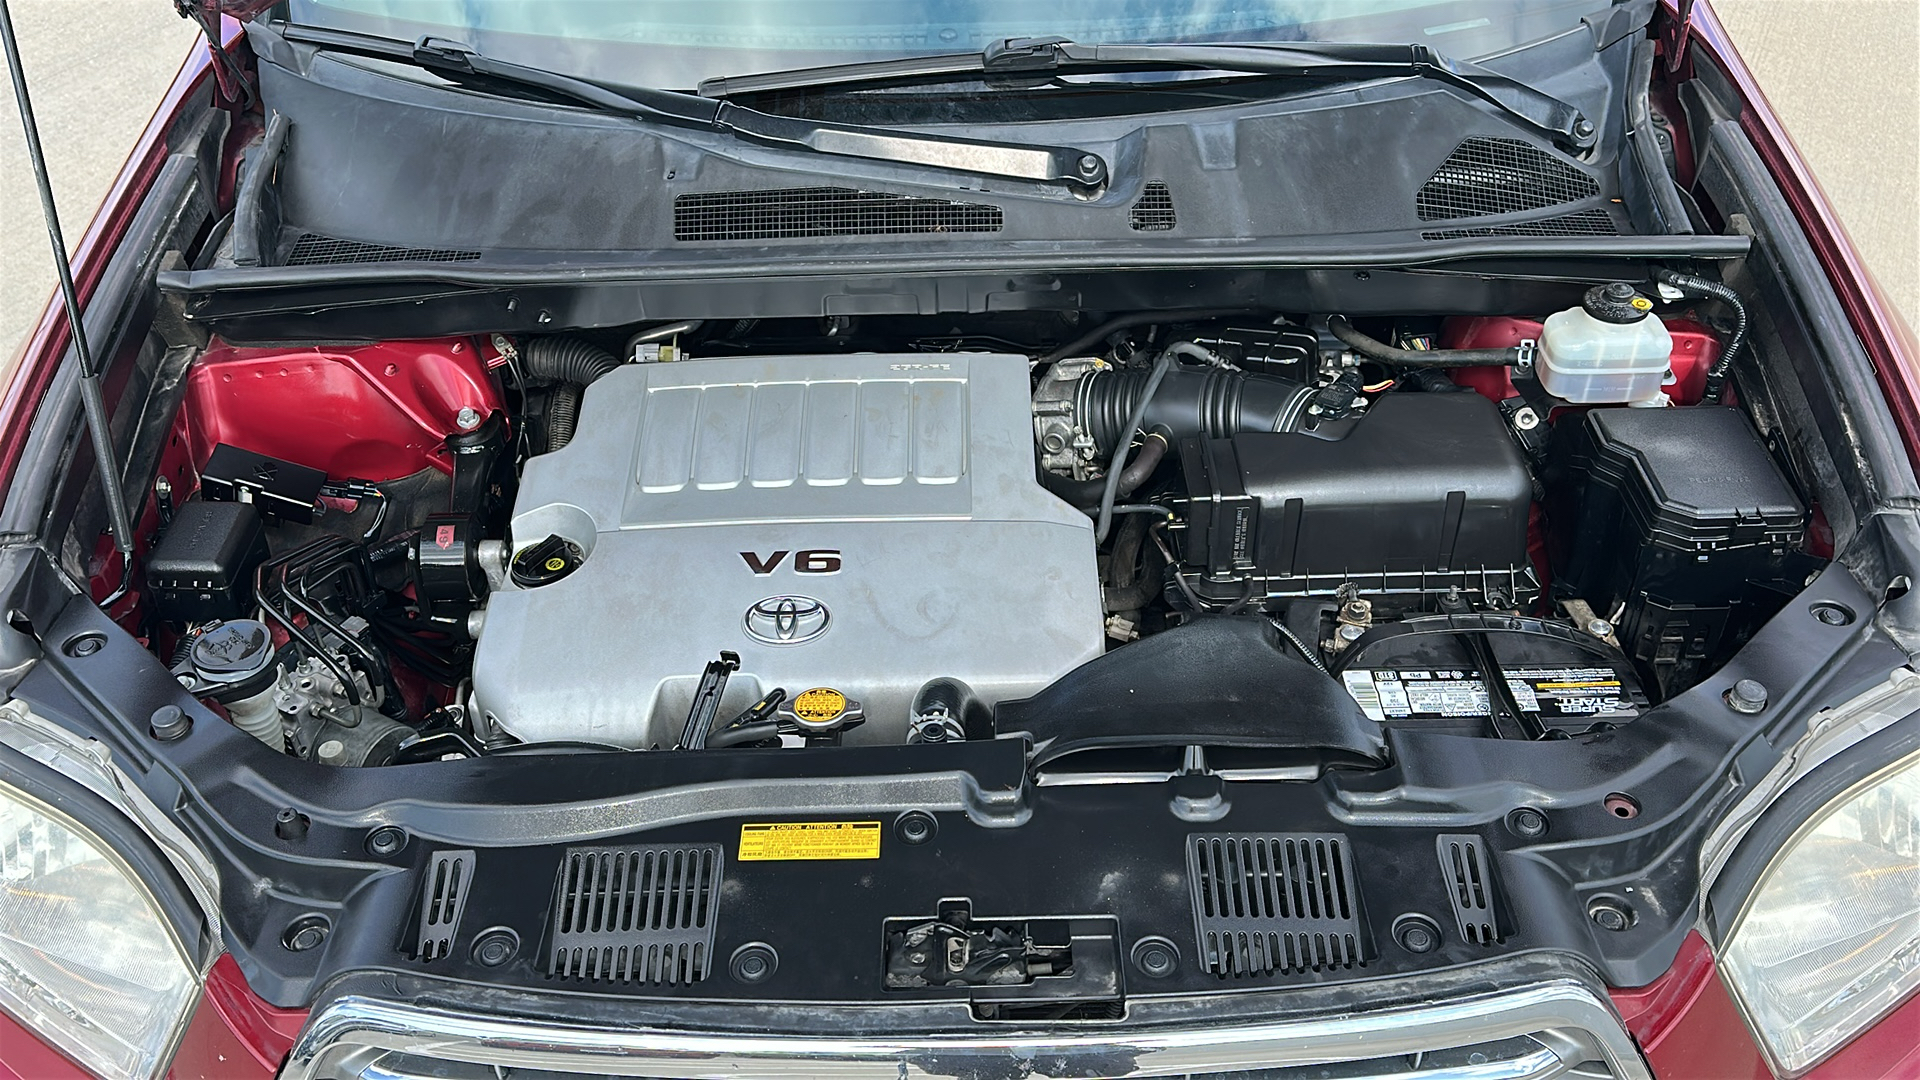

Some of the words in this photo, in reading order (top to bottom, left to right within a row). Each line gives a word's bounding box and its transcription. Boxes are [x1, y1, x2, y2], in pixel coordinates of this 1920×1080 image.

[737, 549, 842, 577] V6
[1558, 697, 1619, 707] START
[1560, 705, 1616, 713] SUPER
